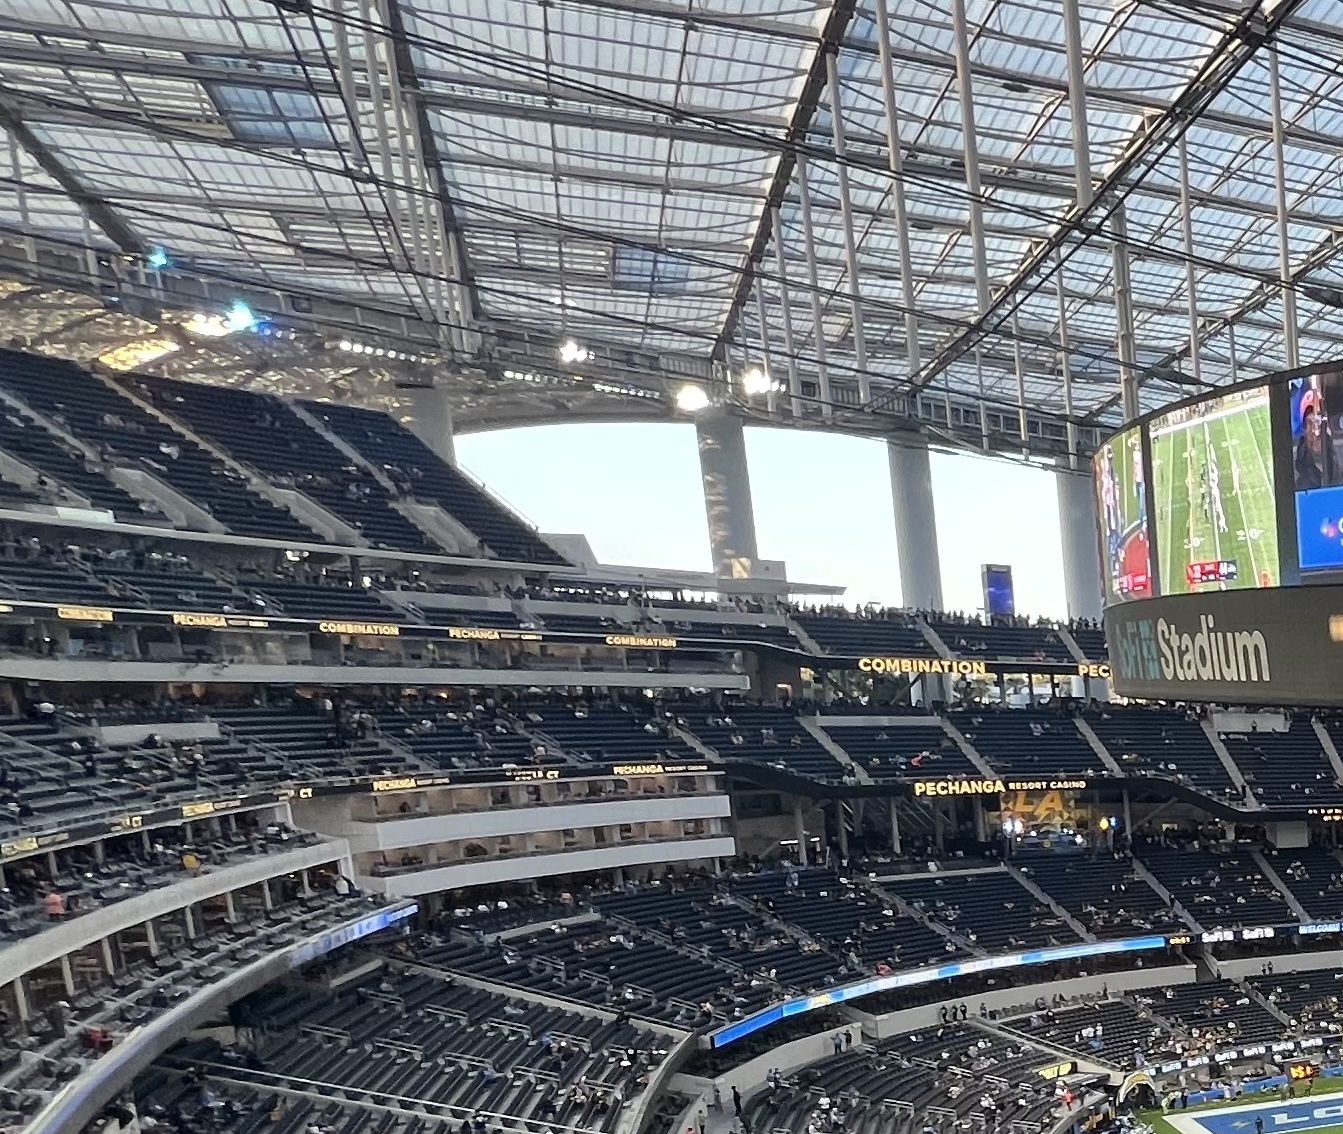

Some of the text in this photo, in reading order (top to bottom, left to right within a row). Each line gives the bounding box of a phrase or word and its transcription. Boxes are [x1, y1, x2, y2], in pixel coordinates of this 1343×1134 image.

[319, 622, 400, 635] COMBINATION
[606, 636, 677, 648] COMBINATION
[1157, 614, 1270, 682] Stadium
[858, 658, 986, 675] COMBINATION
[915, 780, 1086, 796] PECHANGA RESORT CASINO
